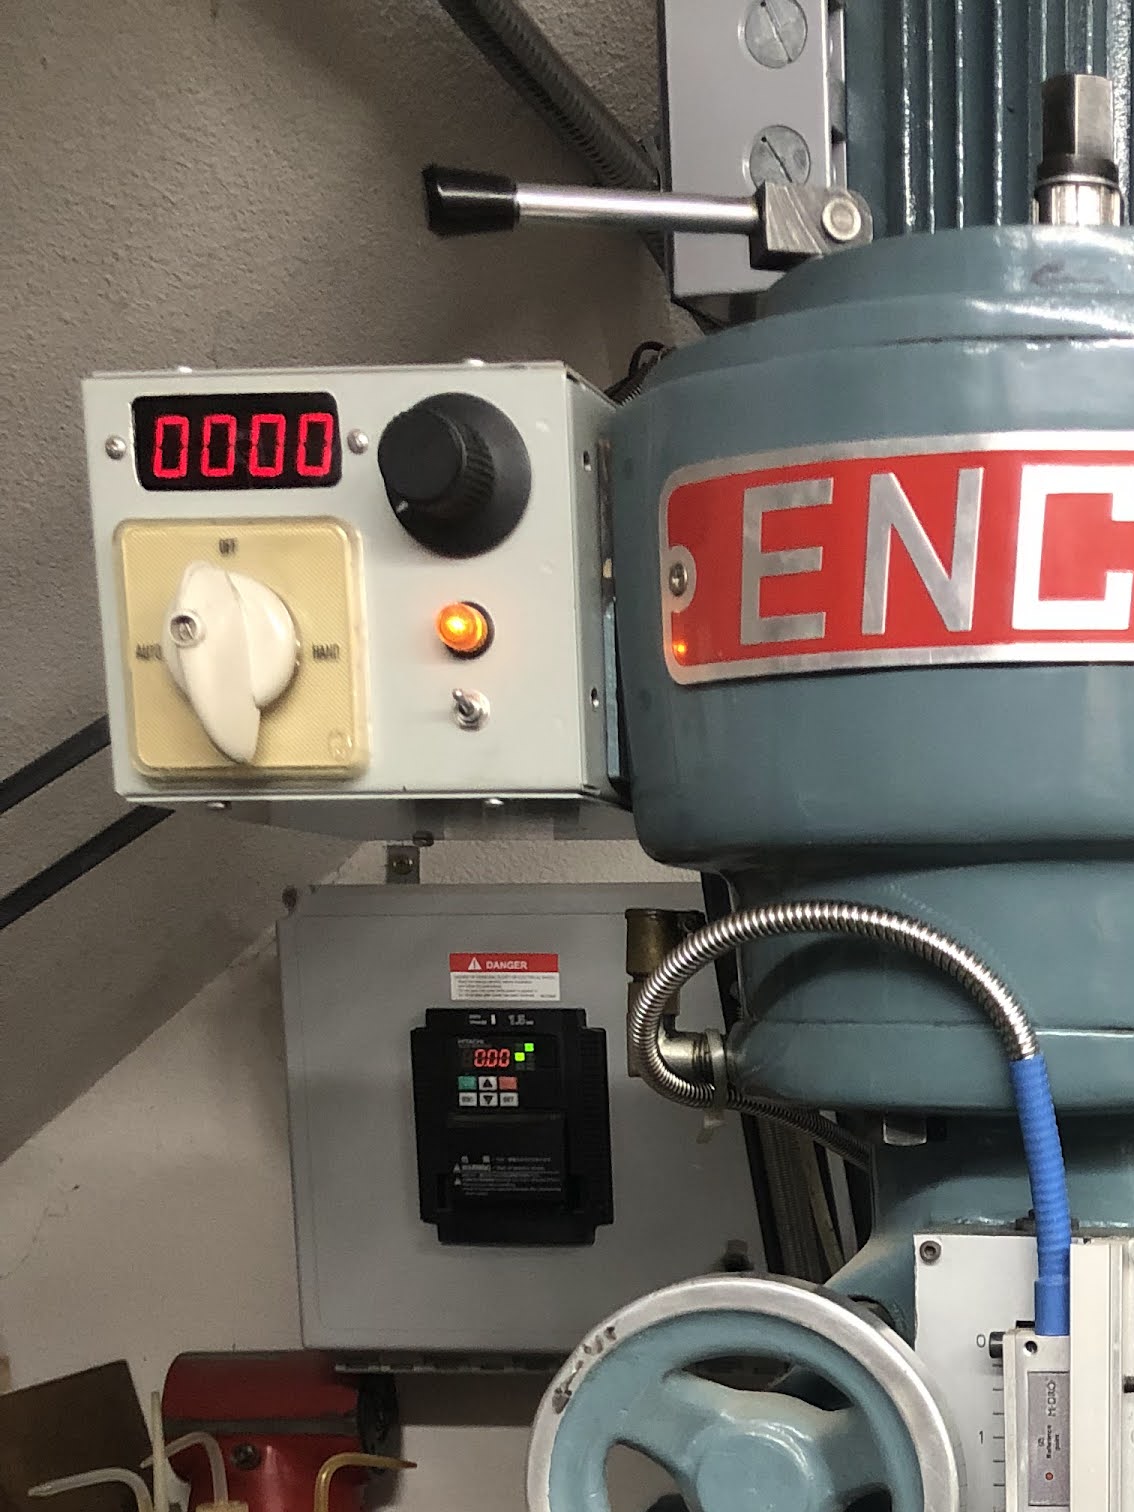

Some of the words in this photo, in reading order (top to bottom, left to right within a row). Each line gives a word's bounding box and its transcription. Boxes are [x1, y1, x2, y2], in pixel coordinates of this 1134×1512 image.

[153, 413, 334, 479] 0000
[486, 961, 528, 970] DANGER
[976, 1334, 986, 1348] 0
[978, 1430, 985, 1445] 1
